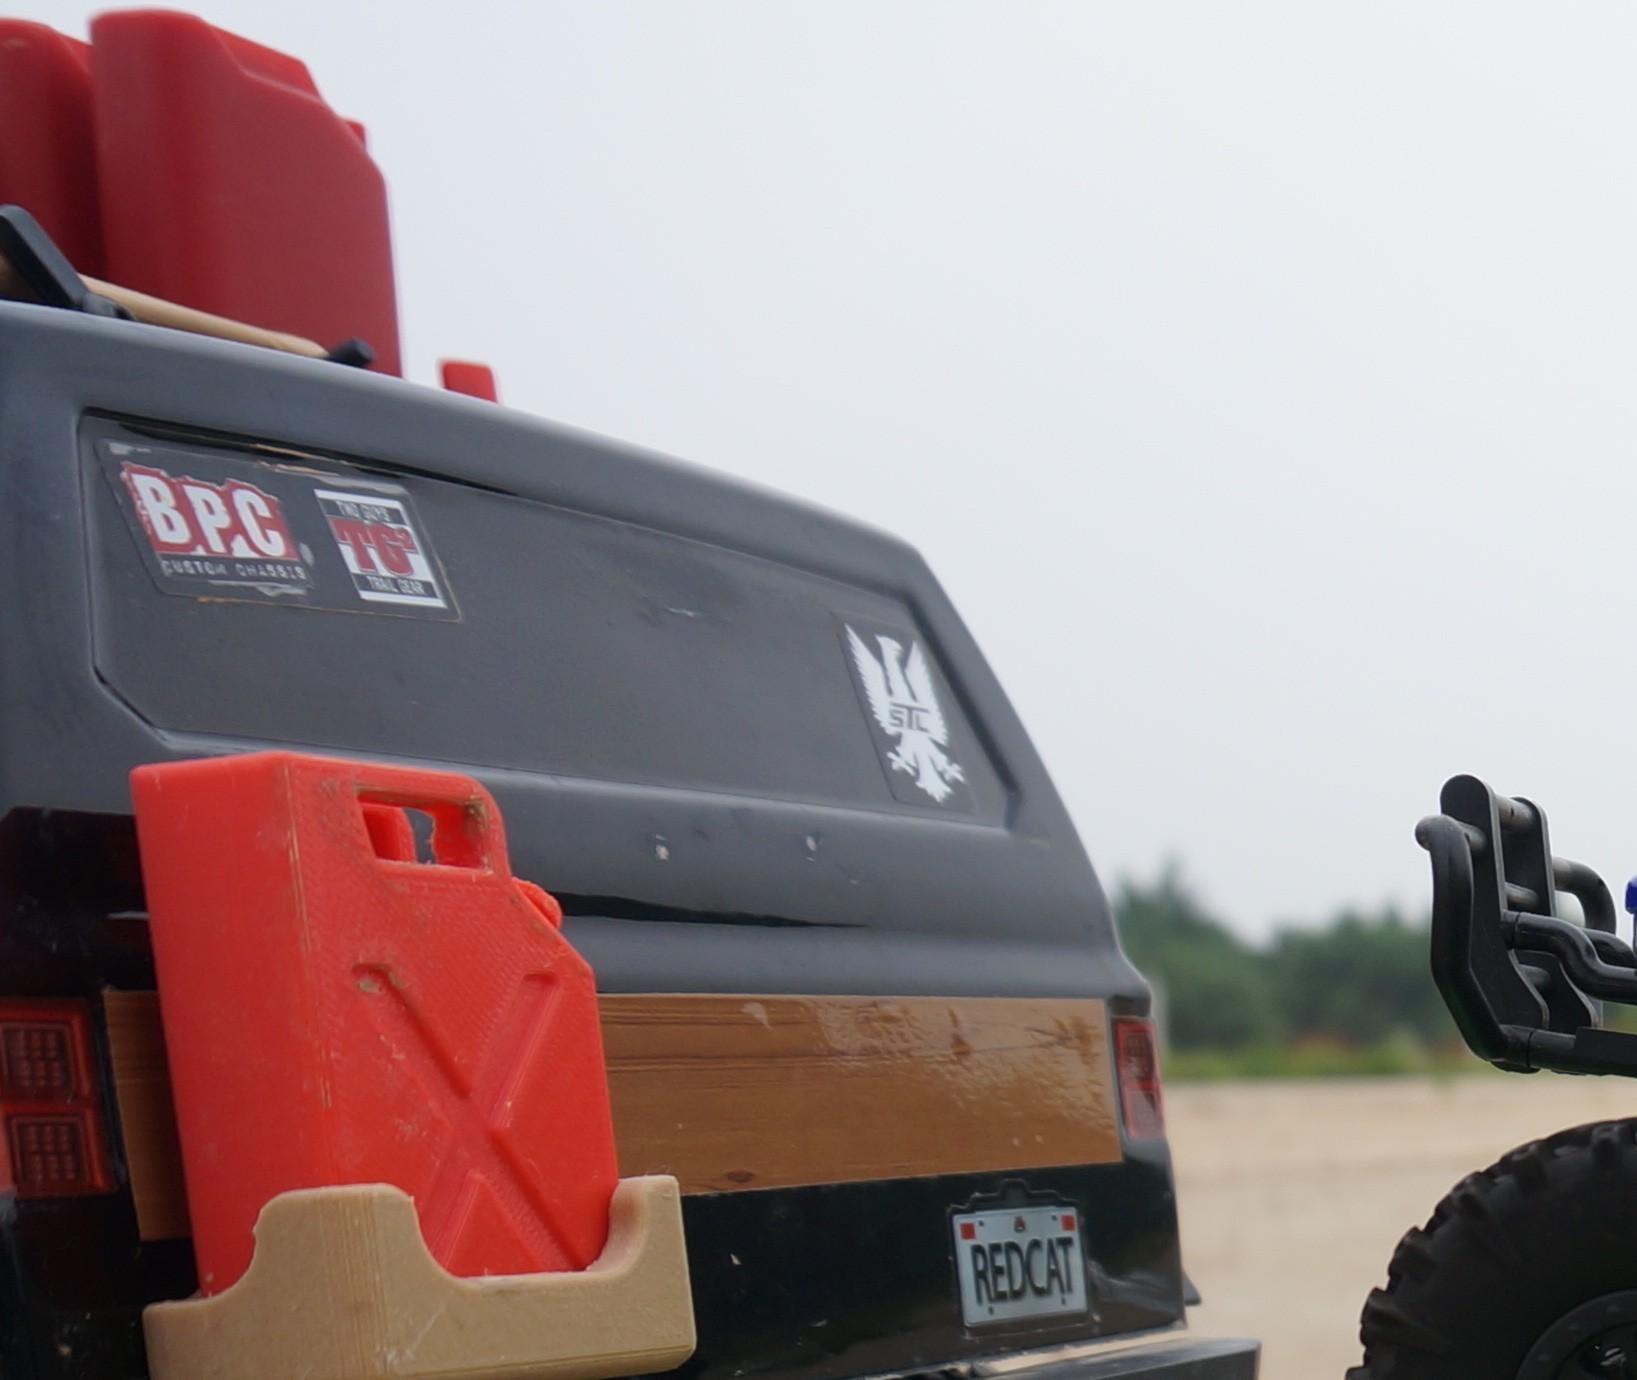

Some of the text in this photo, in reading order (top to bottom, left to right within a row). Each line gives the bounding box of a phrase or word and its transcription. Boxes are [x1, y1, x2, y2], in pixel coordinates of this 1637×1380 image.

[235, 562, 307, 580] CHASSIS
[889, 701, 931, 734] STL
[970, 1236, 1073, 1305] REDCAT
